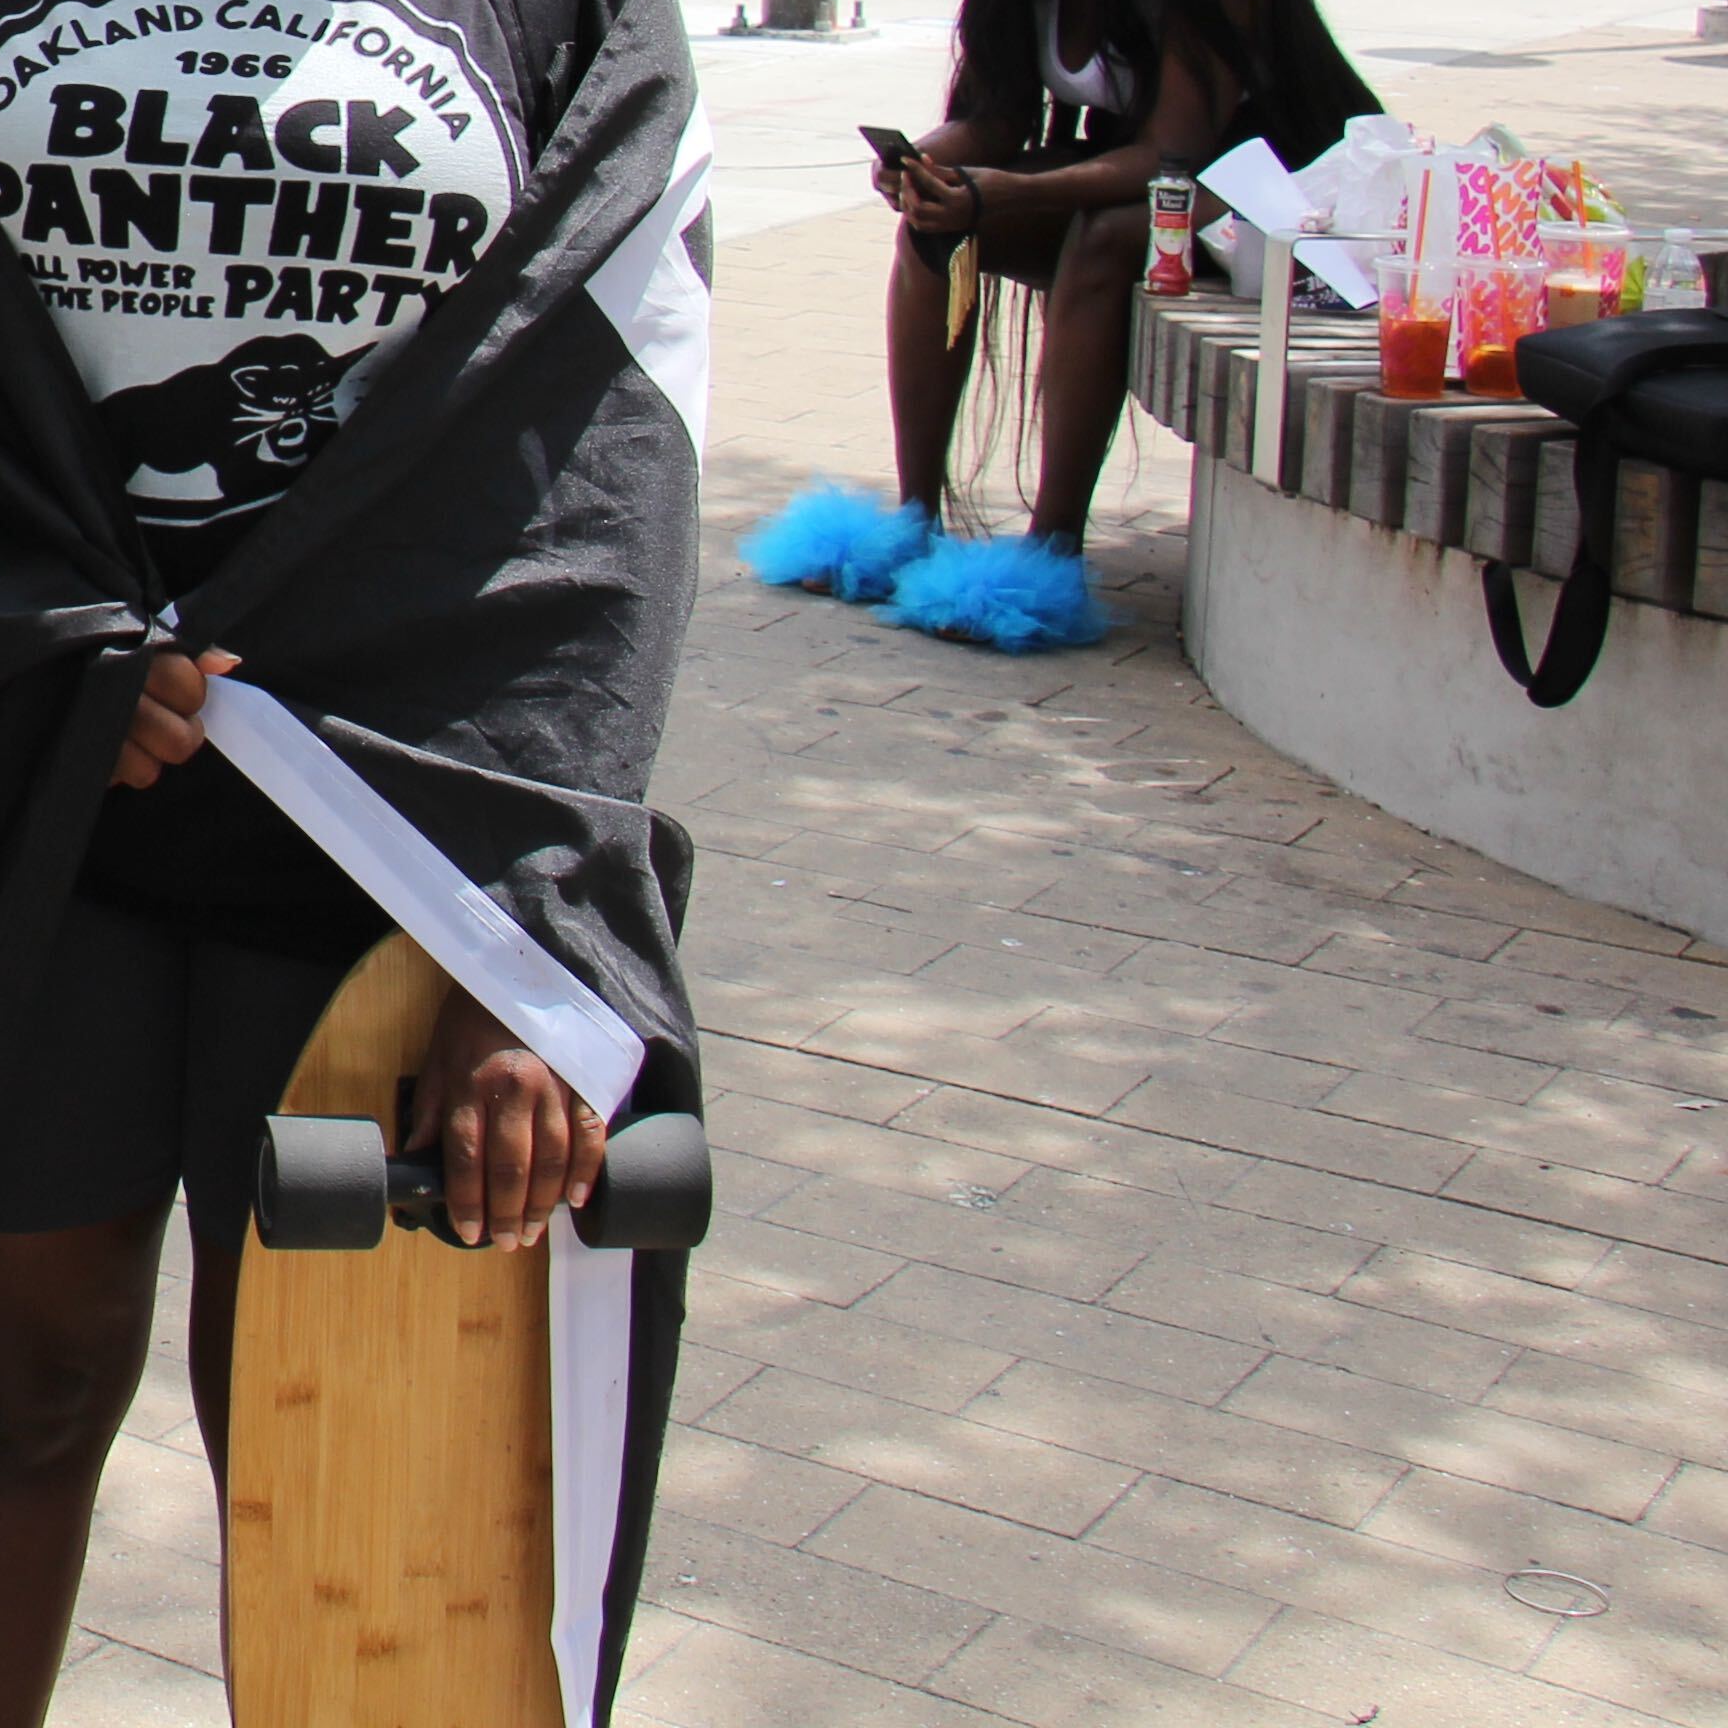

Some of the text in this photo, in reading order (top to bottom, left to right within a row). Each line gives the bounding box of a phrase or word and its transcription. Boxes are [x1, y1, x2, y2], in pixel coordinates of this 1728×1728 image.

[174, 50, 293, 79] 1966
[46, 83, 421, 179] BLACK
[77, 258, 196, 290] POWER
[101, 289, 216, 319] PEOPLE
